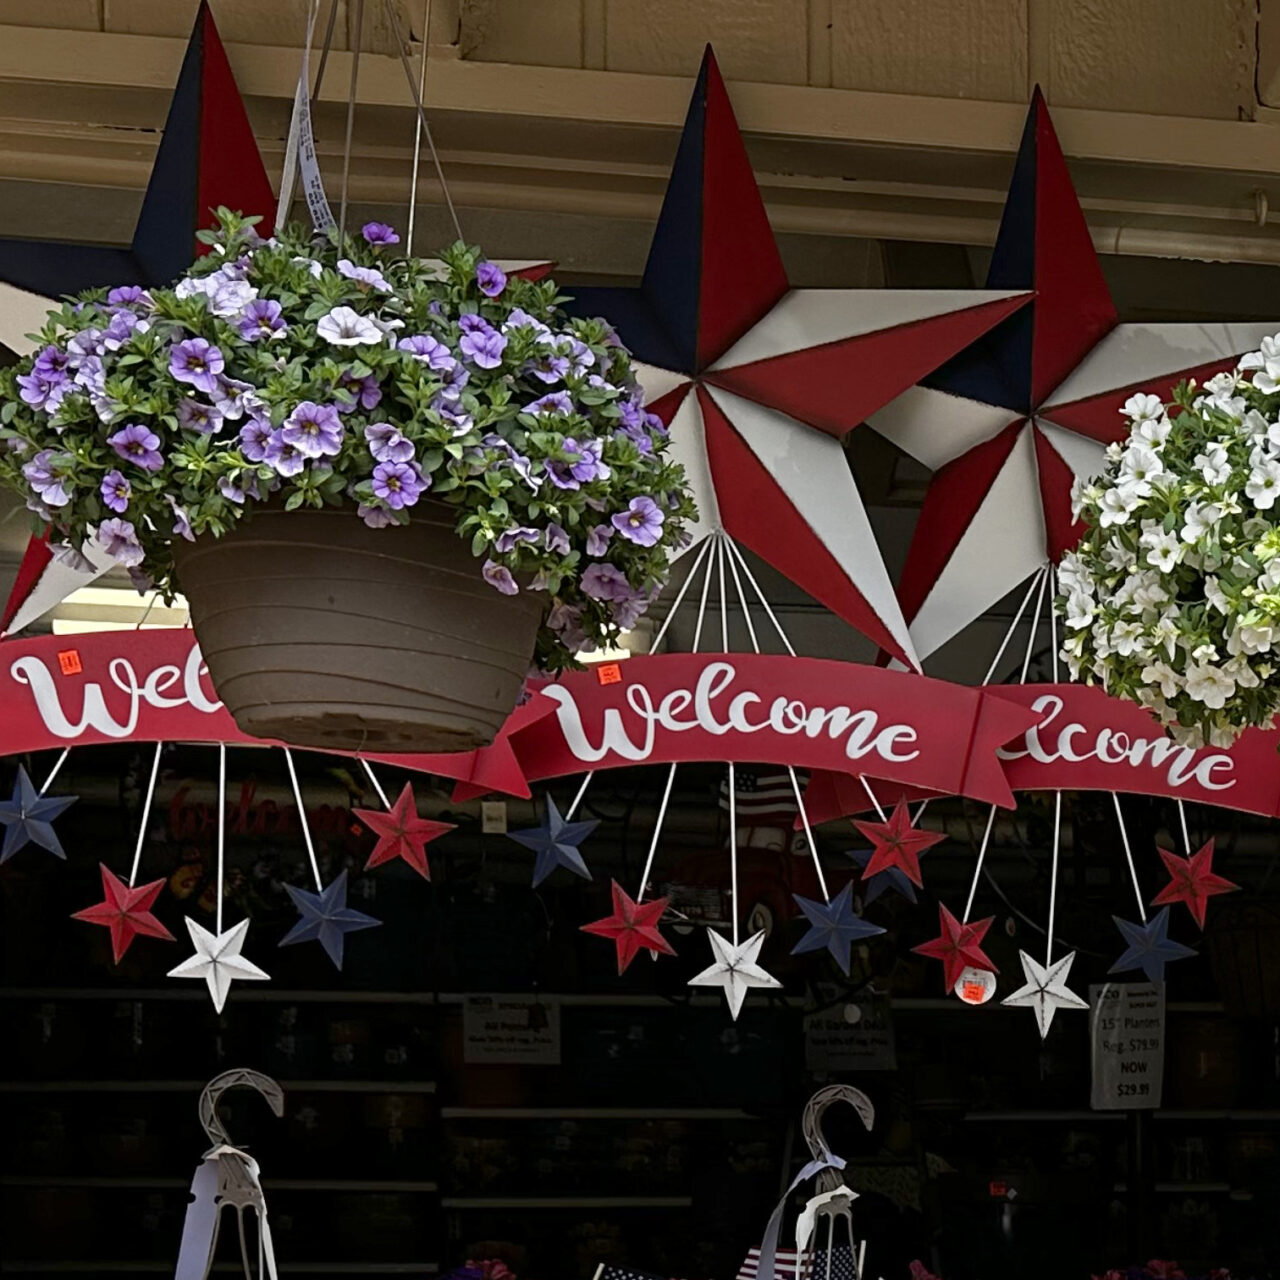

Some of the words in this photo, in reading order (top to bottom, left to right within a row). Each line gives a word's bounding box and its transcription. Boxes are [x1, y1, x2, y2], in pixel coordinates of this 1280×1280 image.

[540, 662, 920, 762] Welcome
[996, 694, 1237, 791] lcome
[1117, 1083, 1149, 1097] $29.99
[1121, 1062, 1147, 1073] NOW
